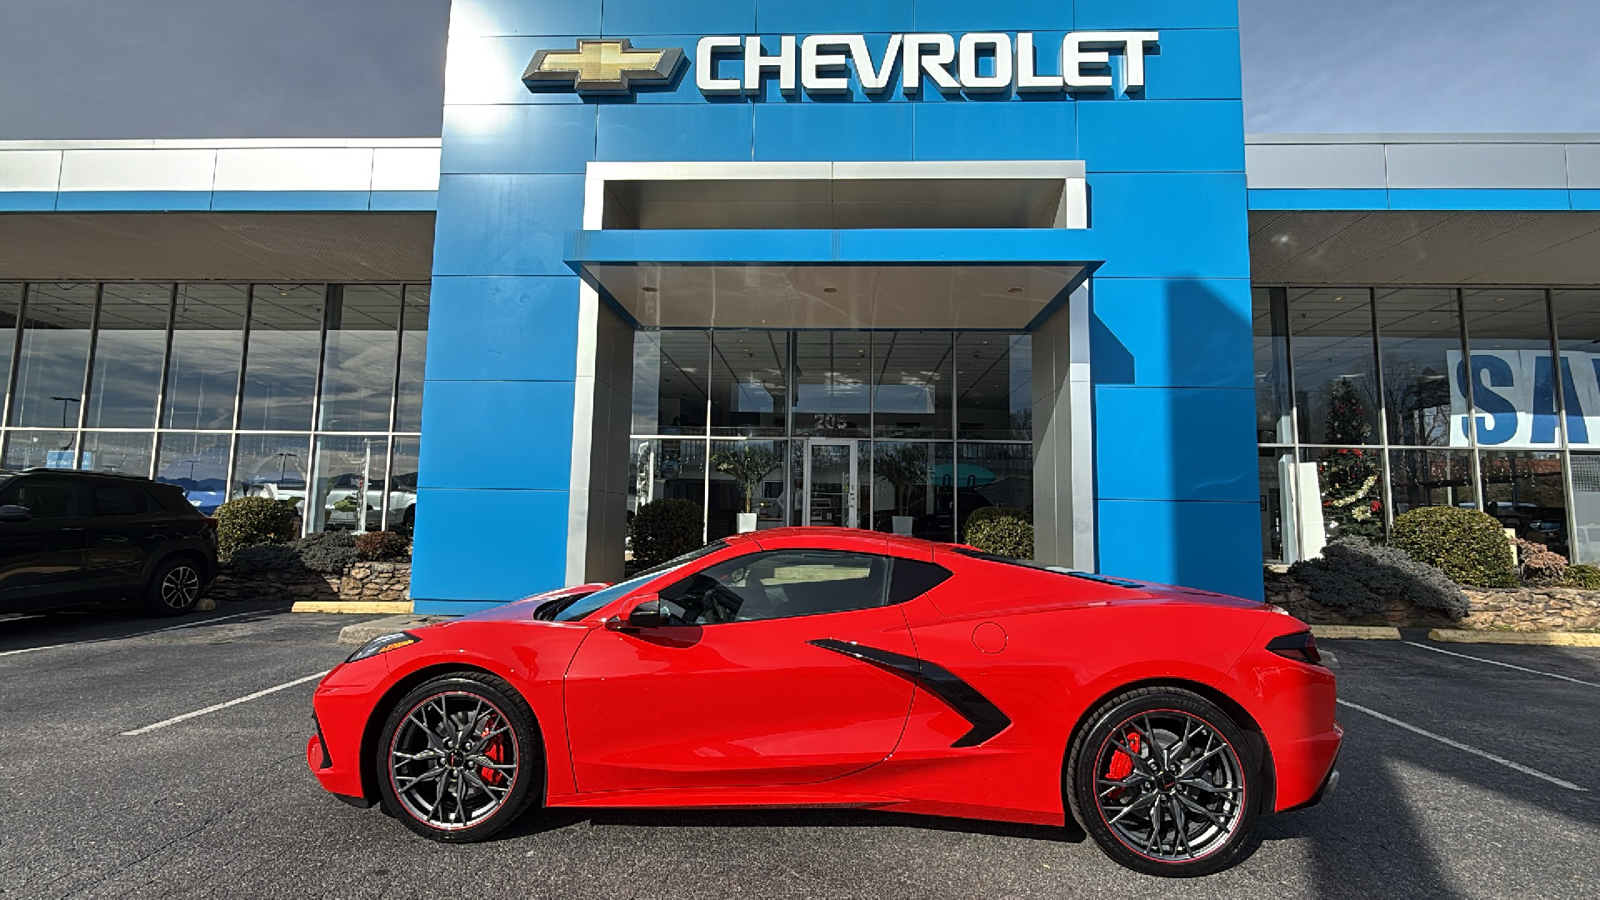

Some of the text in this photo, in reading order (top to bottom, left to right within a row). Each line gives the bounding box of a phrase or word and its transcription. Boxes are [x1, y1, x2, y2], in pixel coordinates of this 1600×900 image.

[696, 31, 1159, 94] CHEVROLET
[814, 413, 848, 429] 205
[1456, 354, 1600, 446] SA
